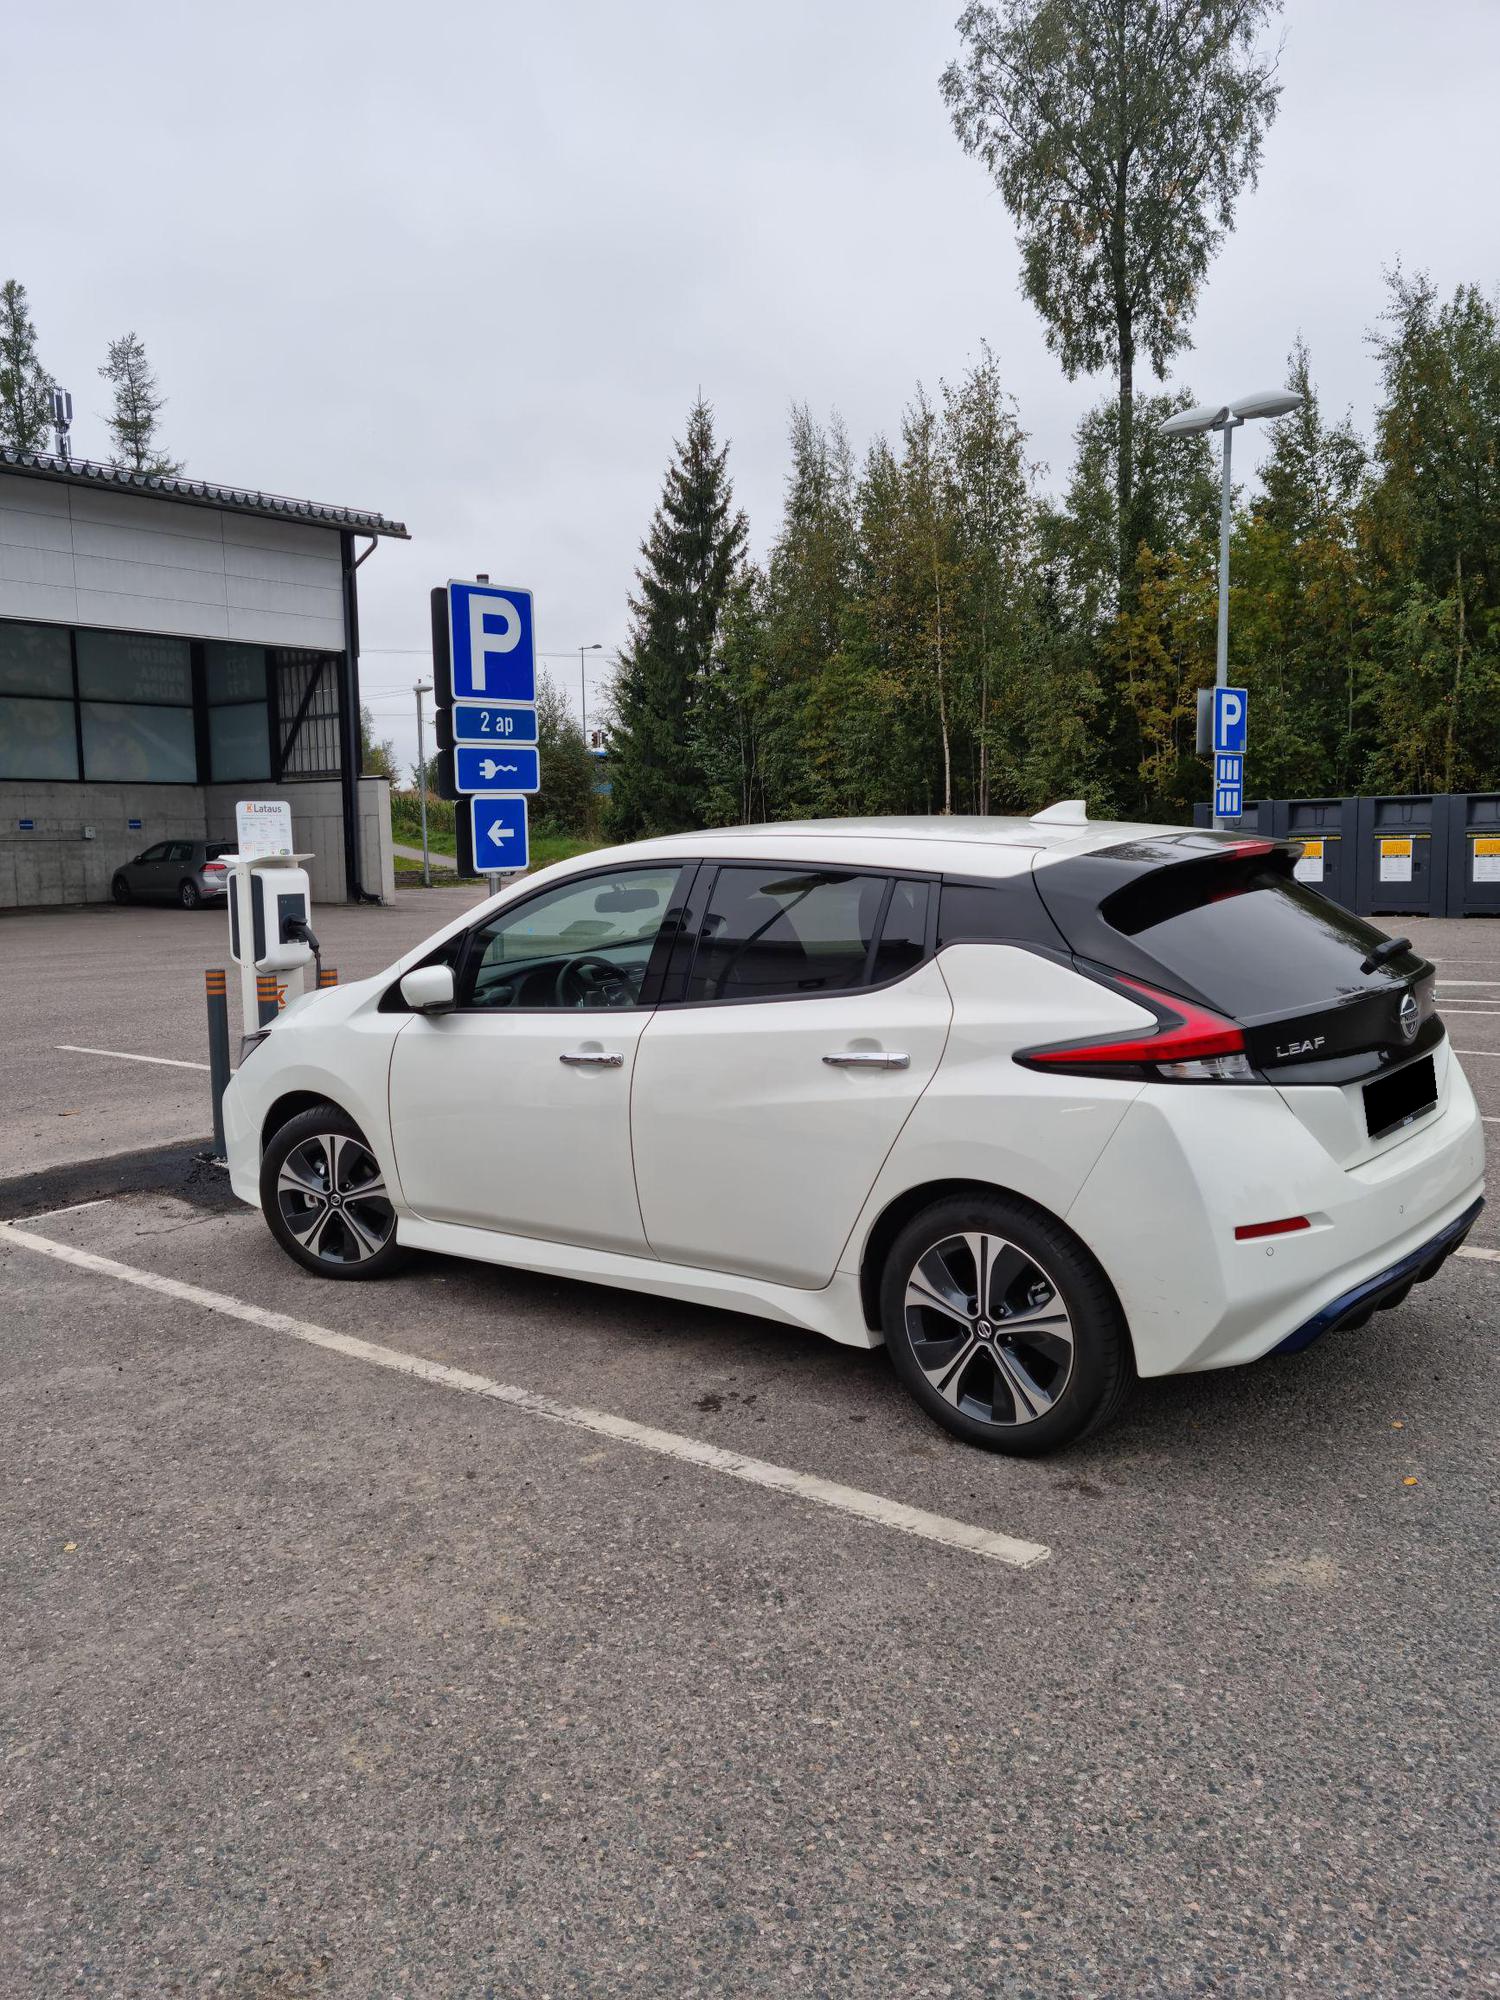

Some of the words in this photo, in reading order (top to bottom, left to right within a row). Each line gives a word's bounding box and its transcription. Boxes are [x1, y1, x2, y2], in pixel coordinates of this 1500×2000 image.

[468, 592, 522, 691] P
[480, 711, 490, 733] 2
[496, 717, 513, 736] ap
[1221, 693, 1242, 747] P
[254, 803, 282, 813] Lataus
[1276, 1036, 1326, 1058] LEAF
